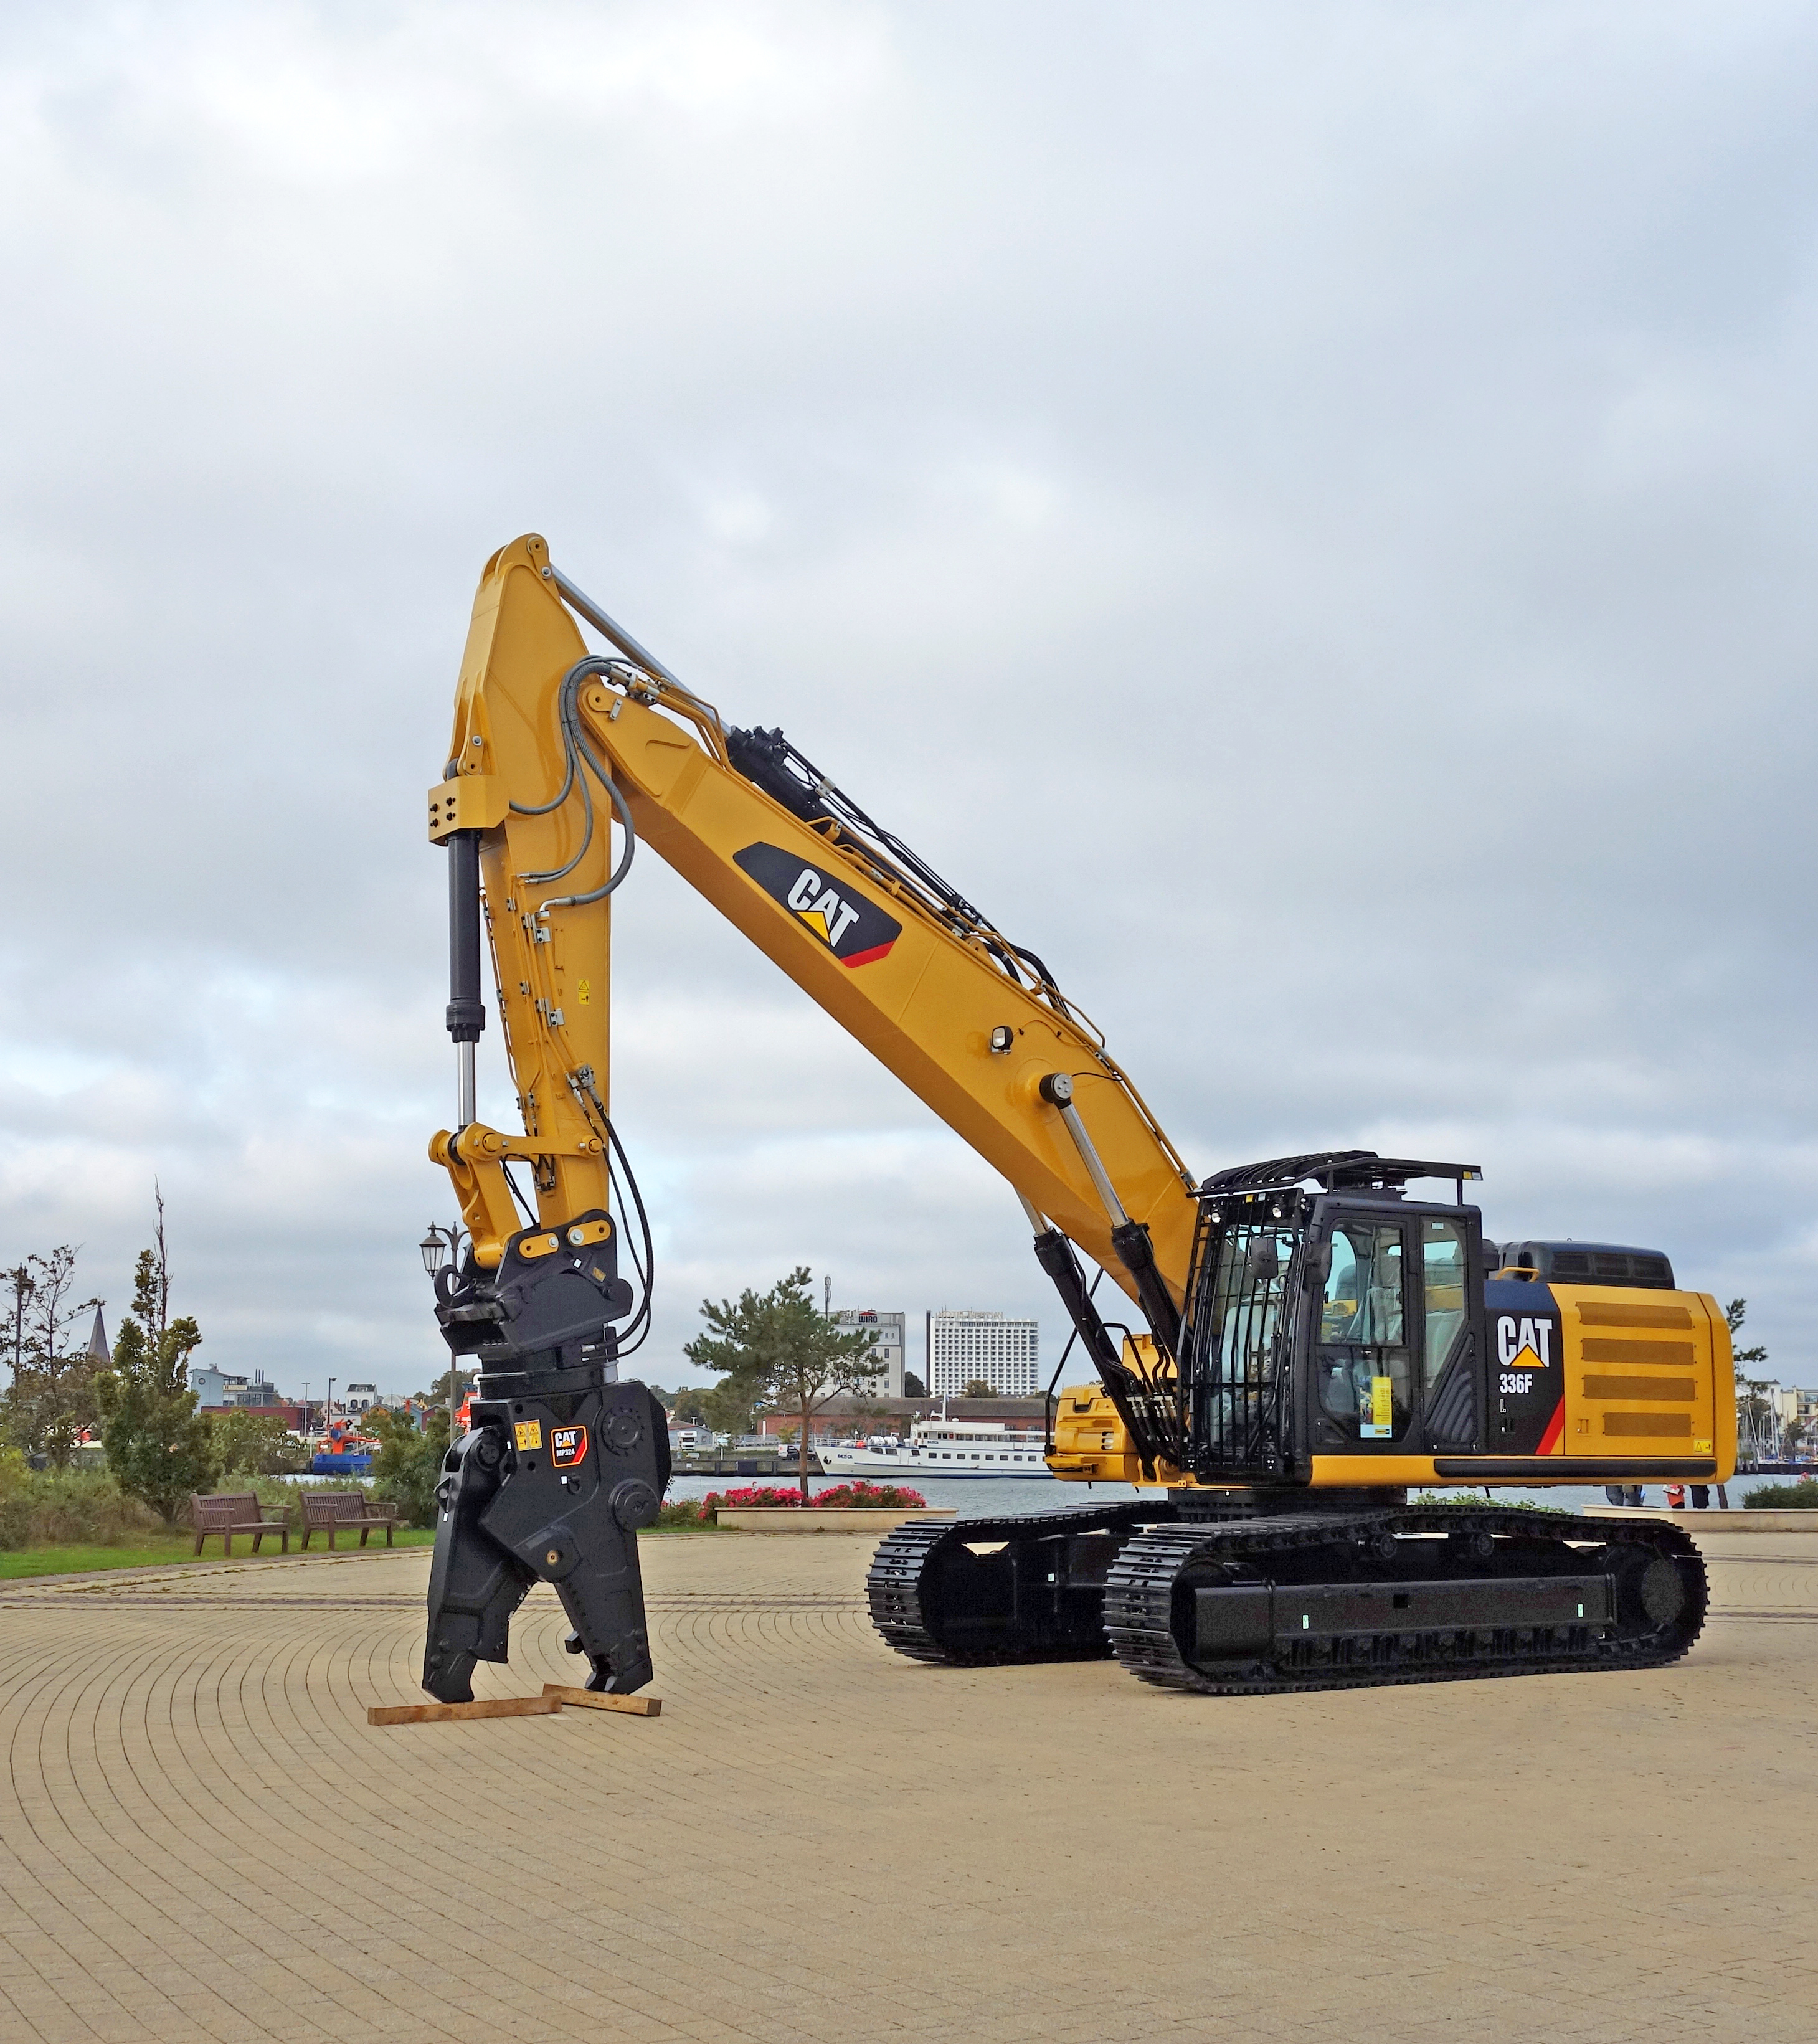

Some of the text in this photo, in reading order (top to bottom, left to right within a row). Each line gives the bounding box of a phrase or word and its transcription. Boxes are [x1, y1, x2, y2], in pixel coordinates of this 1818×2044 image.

[787, 869, 859, 947] CAT
[1497, 1316, 1553, 1368] CAT
[1499, 1373, 1533, 1394] 336F
[555, 1431, 576, 1448] CAT
[556, 1448, 575, 1457] MP324
